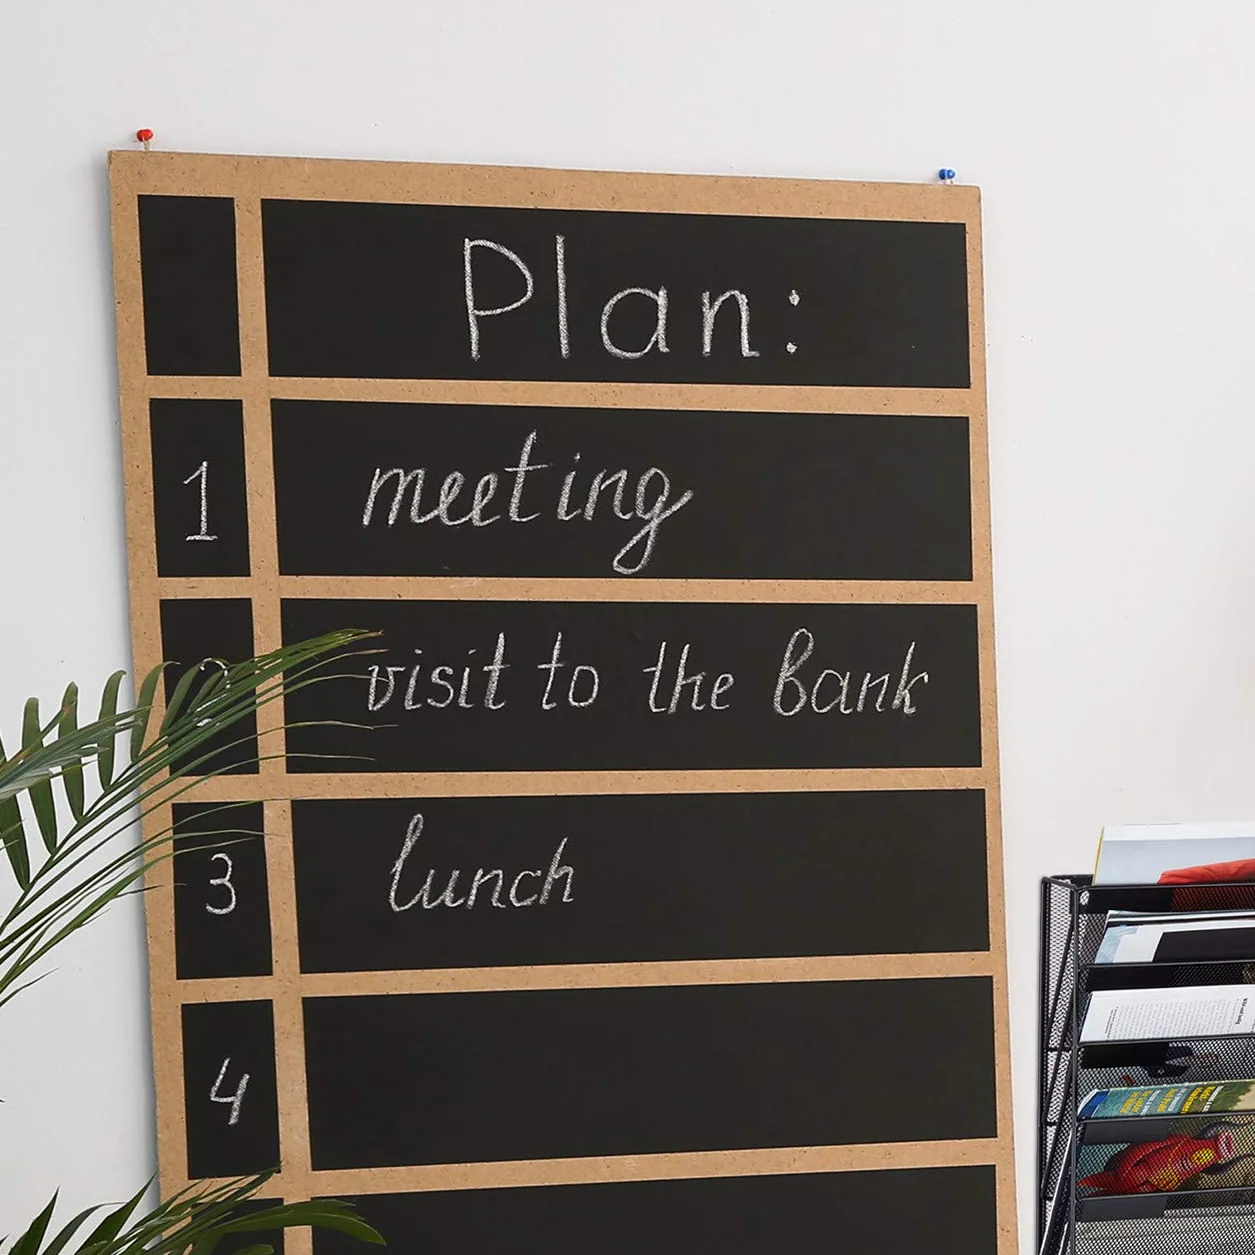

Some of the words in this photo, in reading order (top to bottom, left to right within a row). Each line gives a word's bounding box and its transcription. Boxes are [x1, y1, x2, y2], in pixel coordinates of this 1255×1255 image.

[463, 235, 800, 360] Plan:
[183, 460, 218, 541] 1
[361, 431, 694, 574] meeting
[367, 632, 506, 711] visit
[537, 631, 600, 710] to
[642, 641, 734, 715] the
[773, 628, 930, 717] bank
[205, 852, 237, 915] 3
[388, 813, 575, 912] lunch
[209, 1057, 250, 1125] 4
